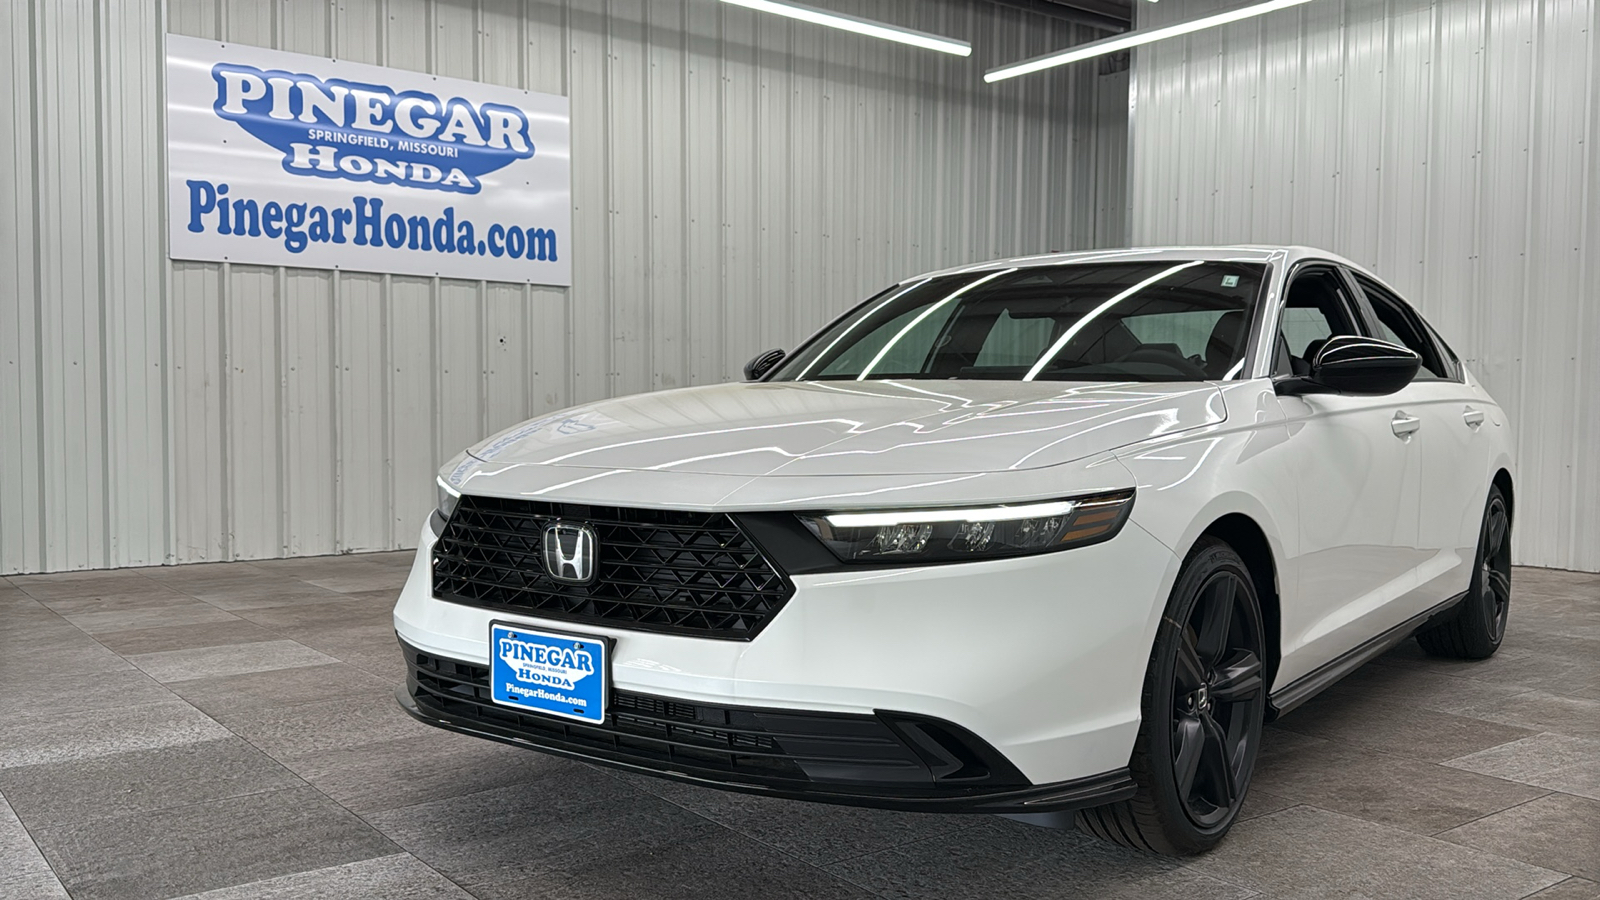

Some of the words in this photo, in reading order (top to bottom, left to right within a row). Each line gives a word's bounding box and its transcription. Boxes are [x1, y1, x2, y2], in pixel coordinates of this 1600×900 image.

[219, 70, 529, 153] PINEGAR
[308, 129, 394, 151] SPRINGFIELD,
[398, 141, 459, 158] MISSOURI
[289, 143, 475, 187] HONDA
[187, 180, 558, 262] PinegarHonda.com
[501, 641, 592, 672] PINEGAR
[518, 668, 573, 687] HONDA
[505, 682, 587, 707] PinegarHonda.com
